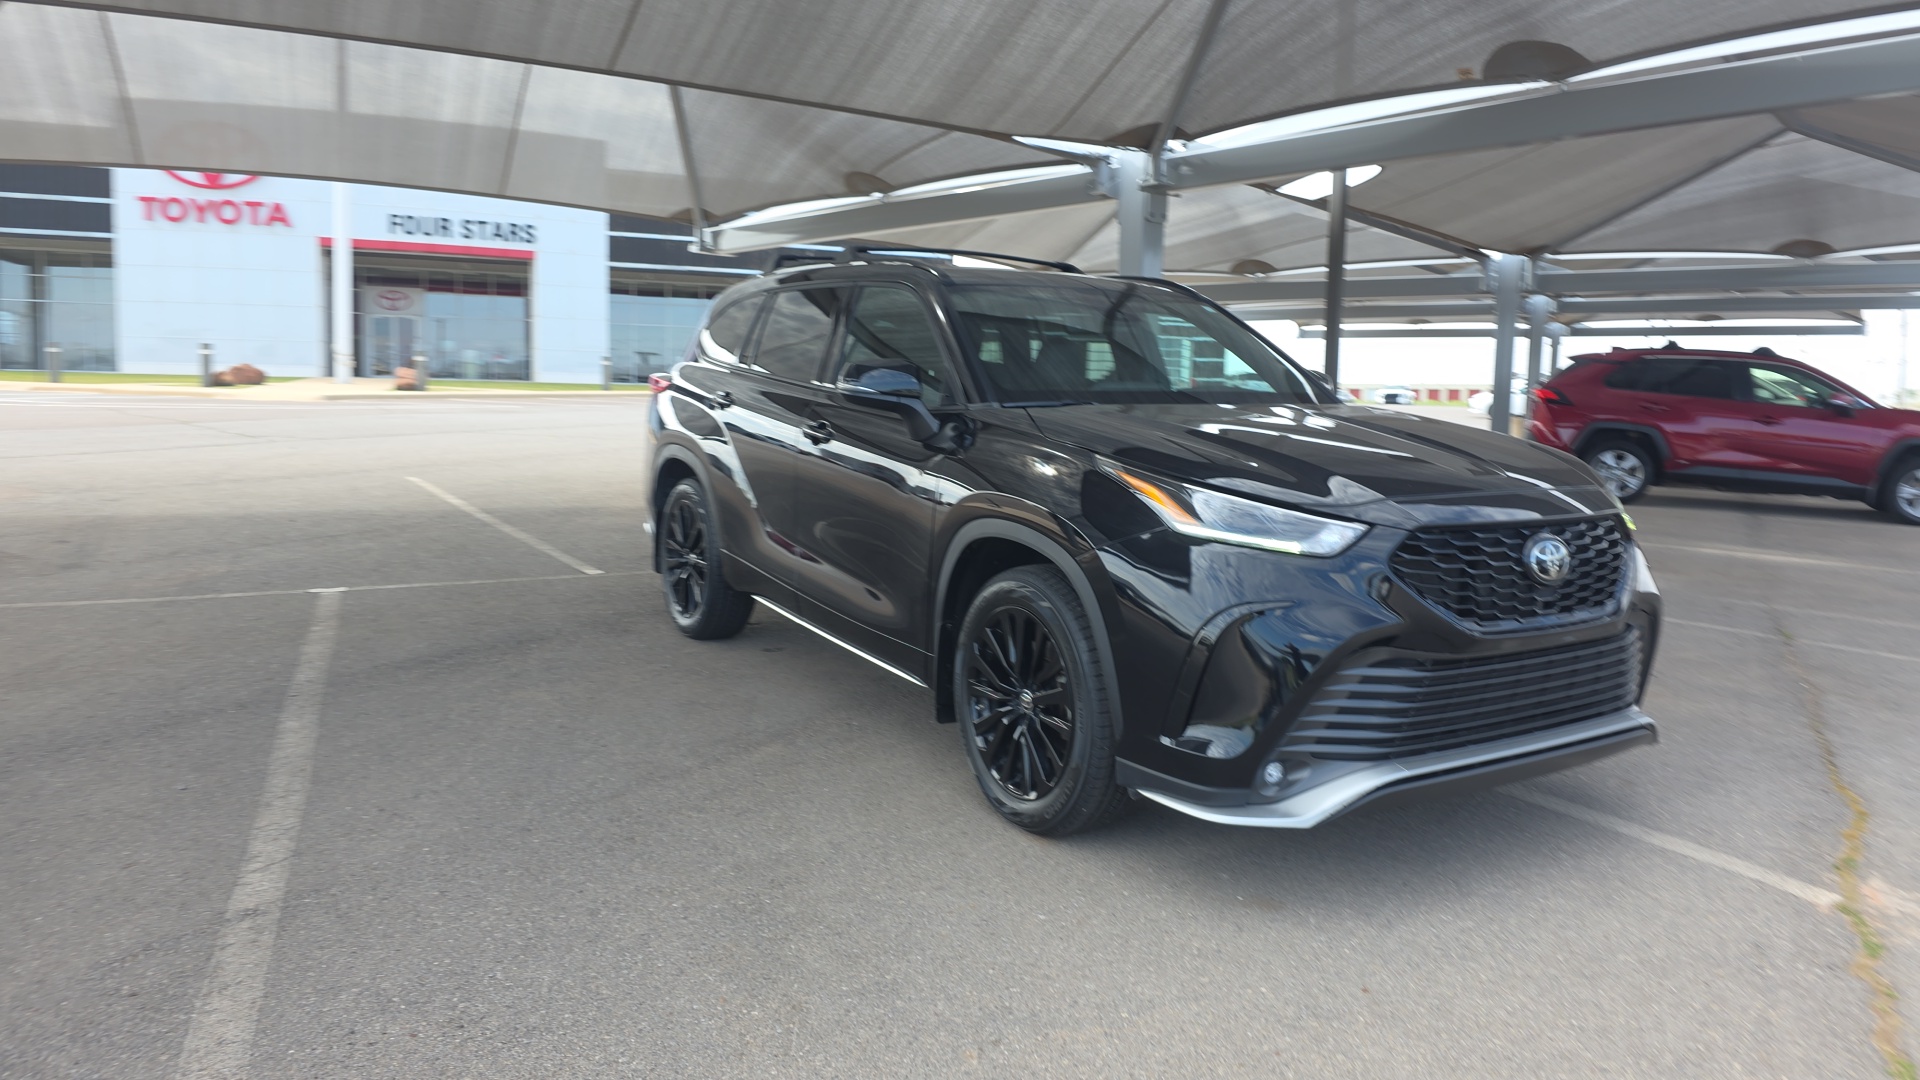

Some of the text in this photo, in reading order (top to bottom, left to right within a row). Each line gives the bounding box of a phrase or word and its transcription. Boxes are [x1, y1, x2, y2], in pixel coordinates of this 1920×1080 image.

[137, 196, 293, 227] TOYOTA
[388, 214, 537, 244] FOUR STARS
